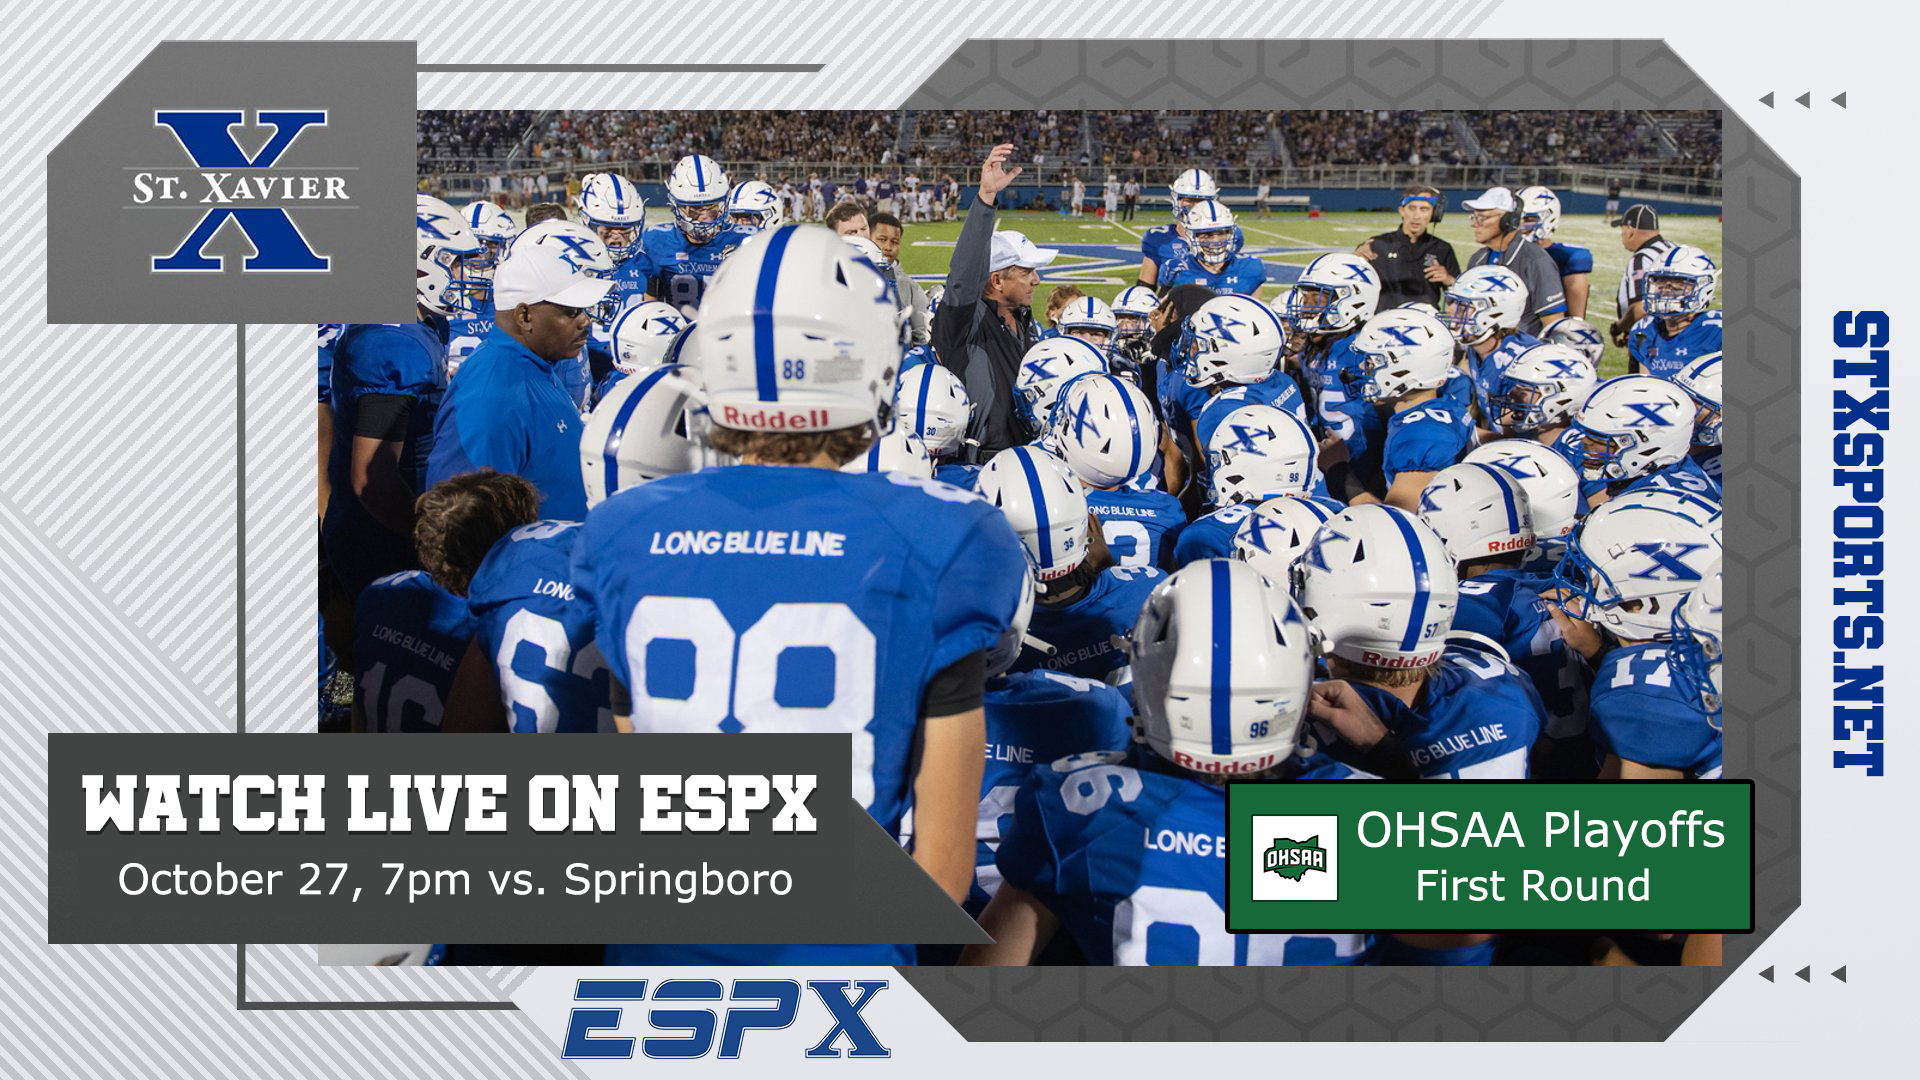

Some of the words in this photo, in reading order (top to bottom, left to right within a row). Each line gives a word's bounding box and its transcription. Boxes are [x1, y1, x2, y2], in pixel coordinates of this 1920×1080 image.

[783, 359, 805, 380] 88
[723, 405, 830, 430] Riddell
[1088, 505, 1110, 515] ONG
[1110, 506, 1136, 516] BLUE
[650, 529, 723, 556] LONG
[723, 529, 789, 556] BLUE
[789, 529, 846, 557] LINE
[533, 577, 576, 601] LONG
[1424, 622, 1439, 639] 57
[372, 624, 404, 645] LONG
[401, 635, 431, 657] BLUE
[428, 647, 455, 671] LINE
[1078, 640, 1111, 661] BLUE
[1362, 650, 1439, 668] Riddell
[1249, 719, 1270, 739] 96
[1428, 733, 1475, 759] BLUE
[1470, 723, 1508, 746] LINE
[995, 743, 1034, 763] LINE
[1174, 751, 1275, 774] Riddell
[1144, 827, 1213, 857] LONG
